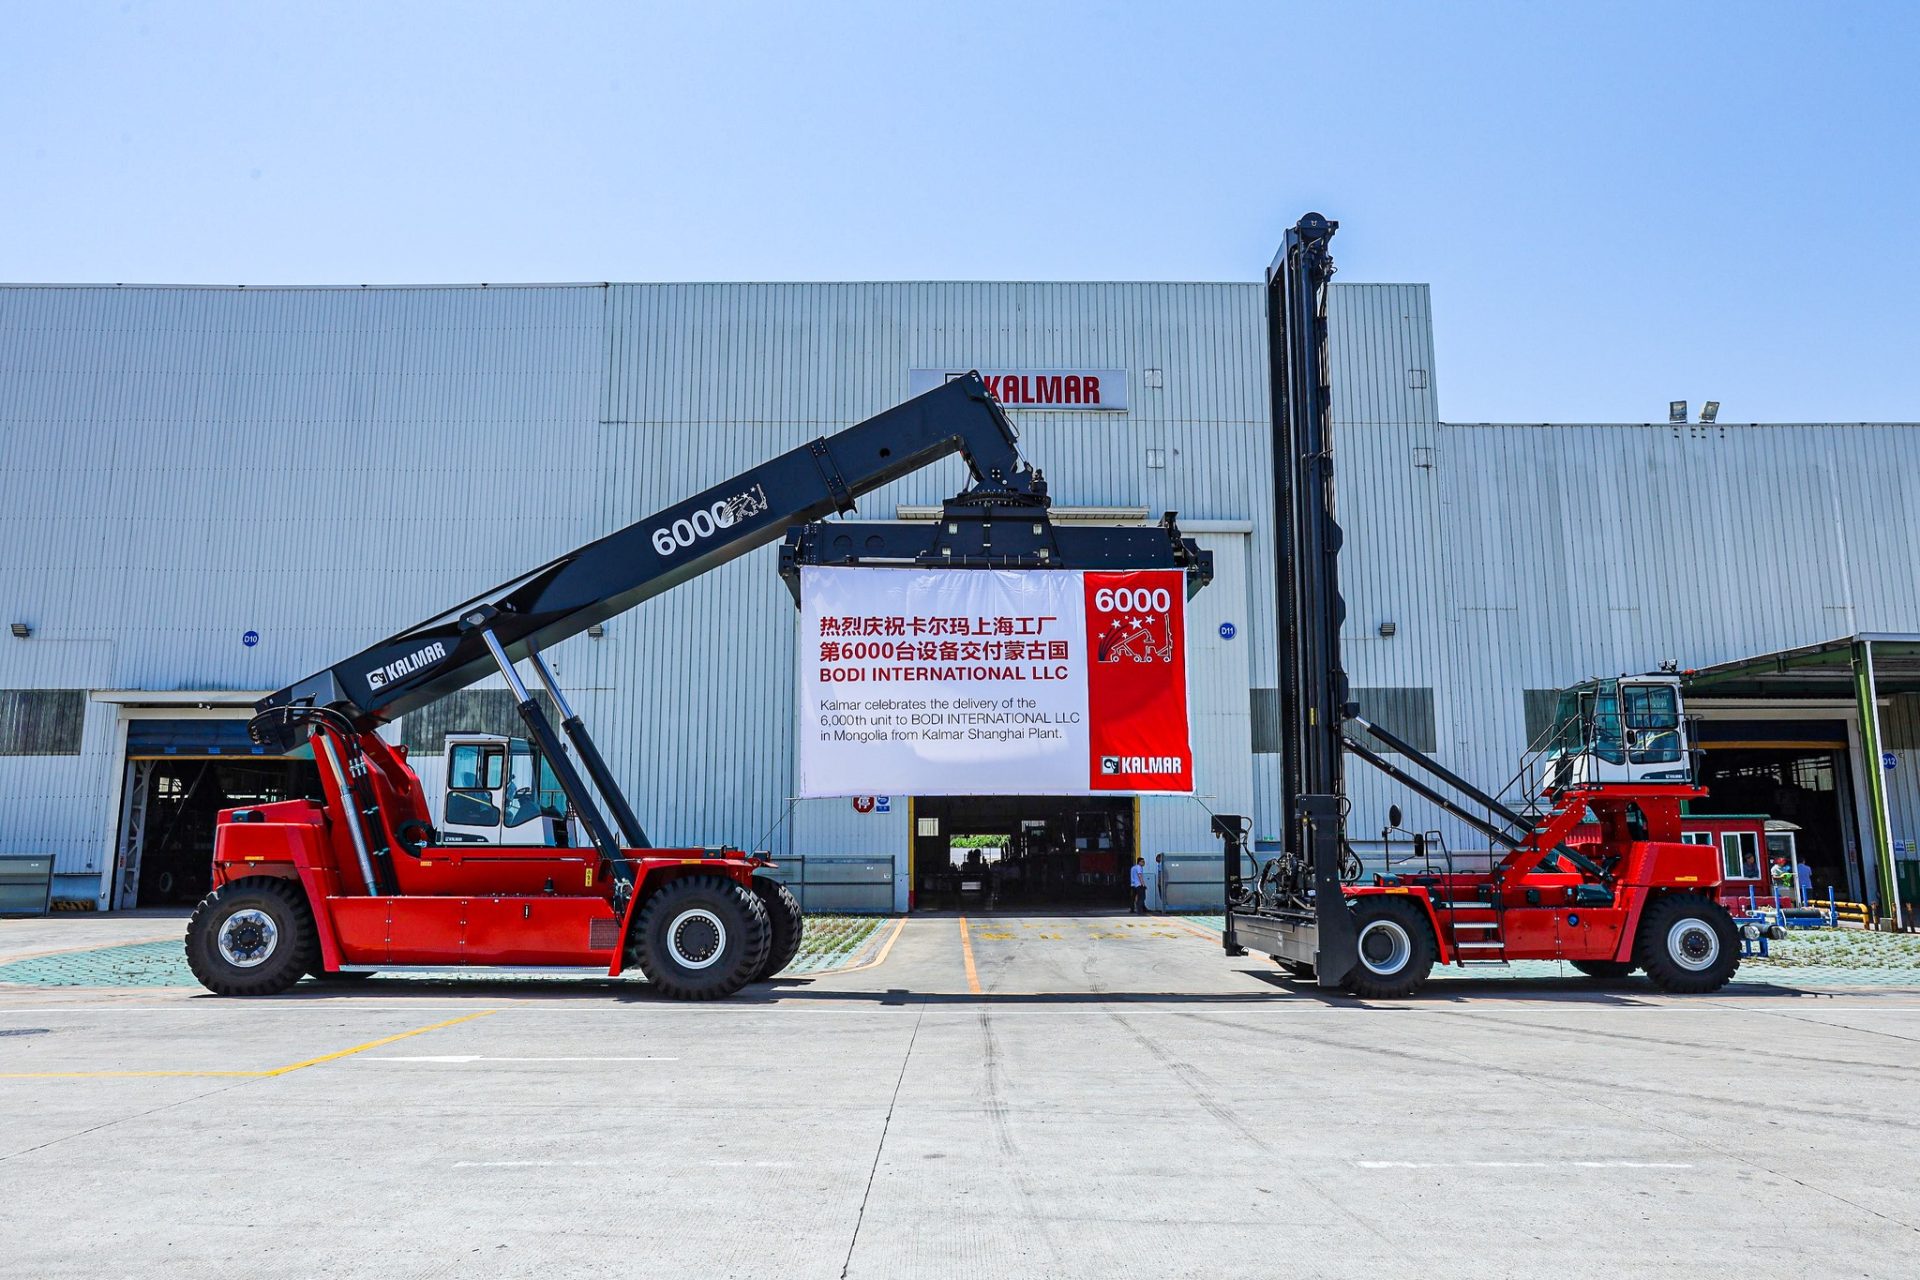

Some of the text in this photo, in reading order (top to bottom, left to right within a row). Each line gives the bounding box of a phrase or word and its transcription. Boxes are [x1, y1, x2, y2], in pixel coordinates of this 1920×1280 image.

[984, 375, 1100, 404] KALMAR
[652, 501, 735, 556] 6000
[1095, 588, 1171, 613] 6000
[820, 616, 1057, 637] 热烈庆祝卡尔玛上海工厂
[1221, 627, 1234, 635] D11
[244, 635, 258, 643] D10
[820, 640, 1069, 662] 第6000台设备交付蒙古国
[385, 641, 446, 682] KALMAR
[820, 665, 1069, 682] BODI INTERNATIONAL LLC
[820, 697, 1037, 712] Kalmar celebrates the delivery of the
[820, 711, 1080, 727] 6,000th unit to BODI INTERNATIONAL LLC
[820, 727, 1063, 744] in Mongolia from Kalmar Shanghai Plant.
[1121, 757, 1182, 774] KALMAR
